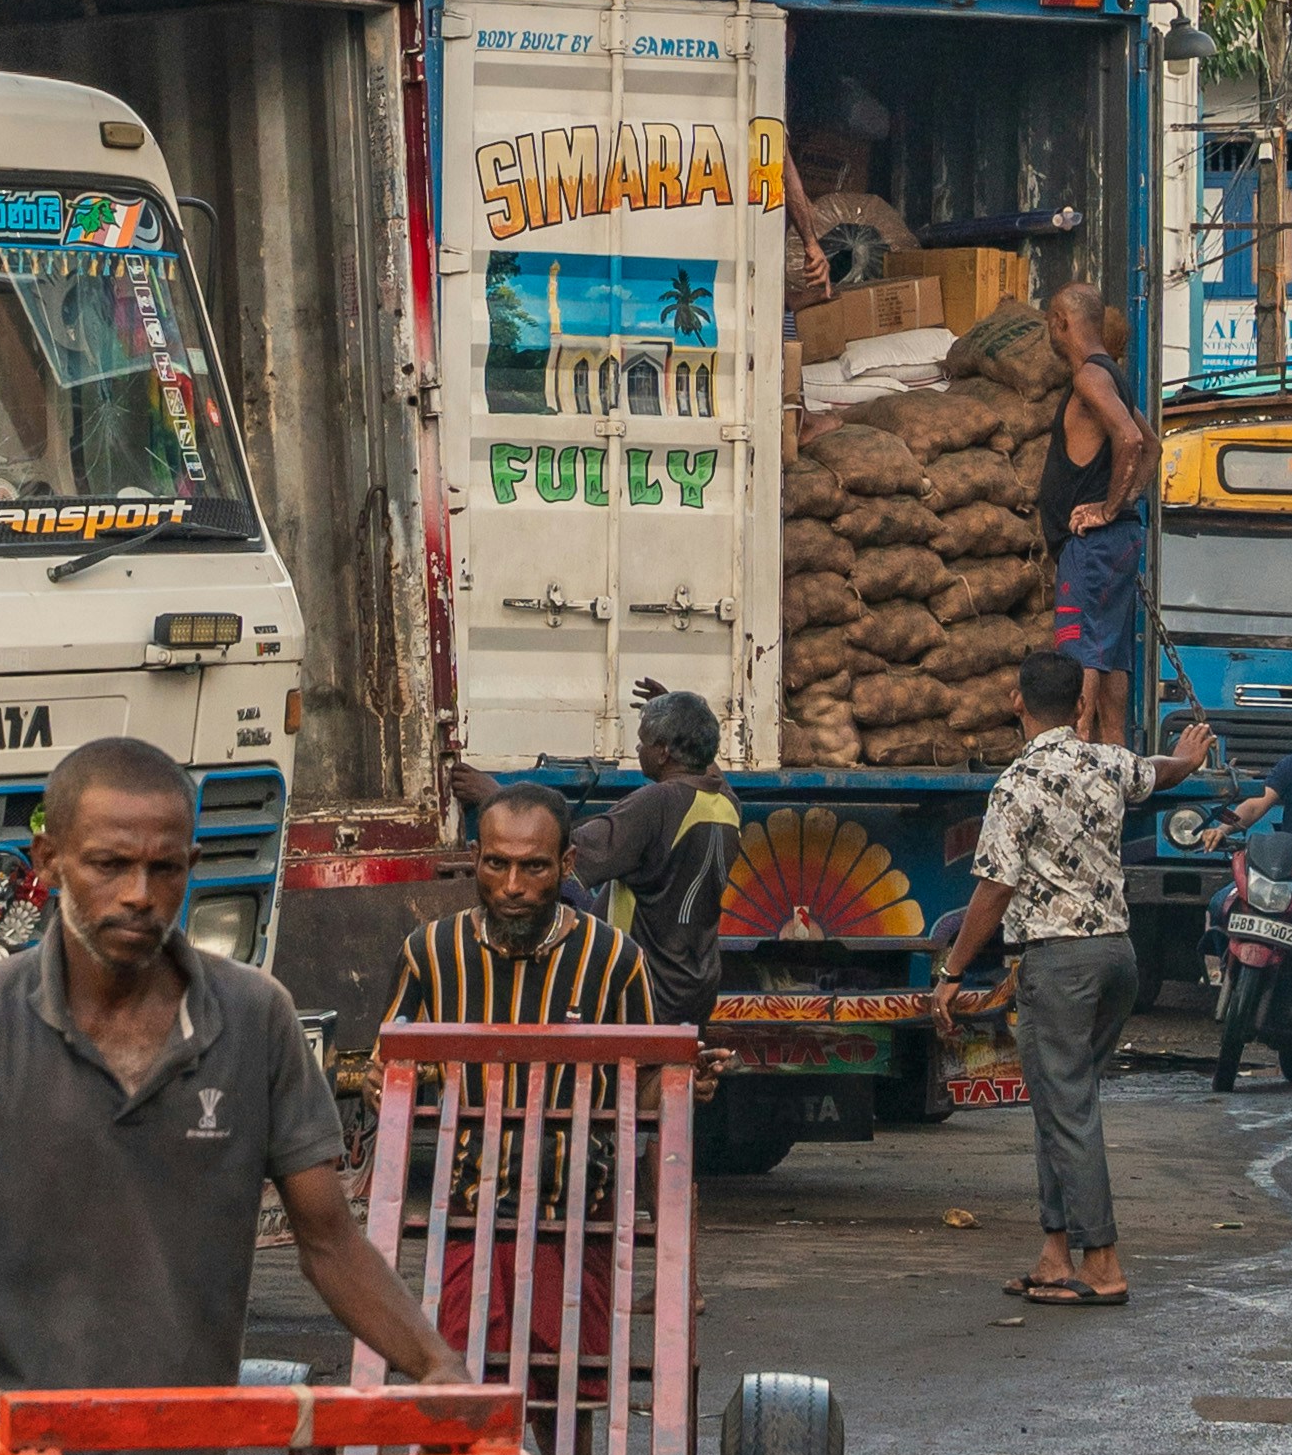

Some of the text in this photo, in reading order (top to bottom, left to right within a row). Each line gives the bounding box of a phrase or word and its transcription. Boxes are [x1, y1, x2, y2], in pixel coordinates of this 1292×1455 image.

[476, 30, 720, 59] BODY BUILT BY SAMEERA
[489, 443, 719, 510] FULLY
